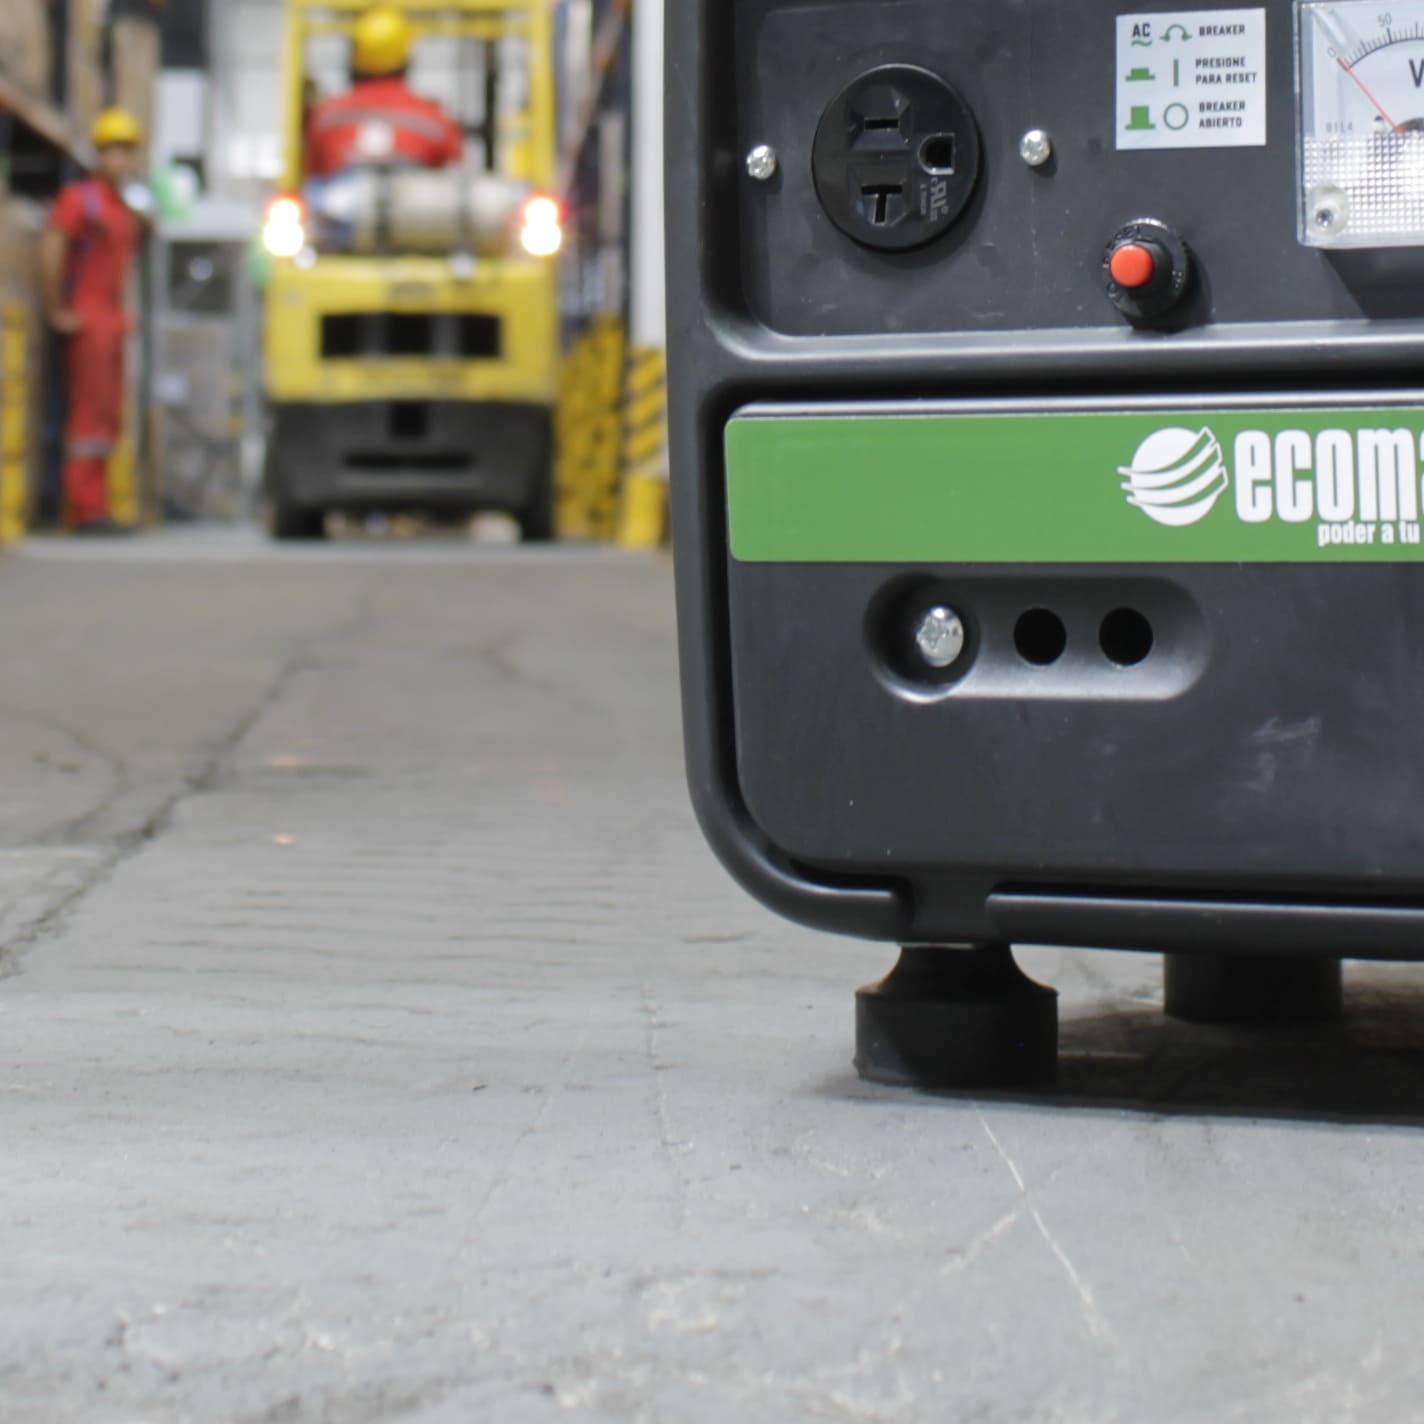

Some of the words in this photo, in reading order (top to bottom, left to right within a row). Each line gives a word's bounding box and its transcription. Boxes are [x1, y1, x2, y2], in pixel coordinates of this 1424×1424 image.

[1378, 12, 1393, 26] 50
[1132, 23, 1151, 38] AC
[1199, 24, 1246, 37] BREAKER
[1196, 56, 1246, 69] PRESIONE
[1196, 73, 1222, 85] PARA
[1226, 72, 1257, 84] RESET
[1199, 100, 1246, 113] BREAKER
[1199, 116, 1243, 129] ABIERTO
[1317, 521, 1376, 547] poder
[1381, 525, 1395, 544] a
[1399, 522, 1420, 544] tu
